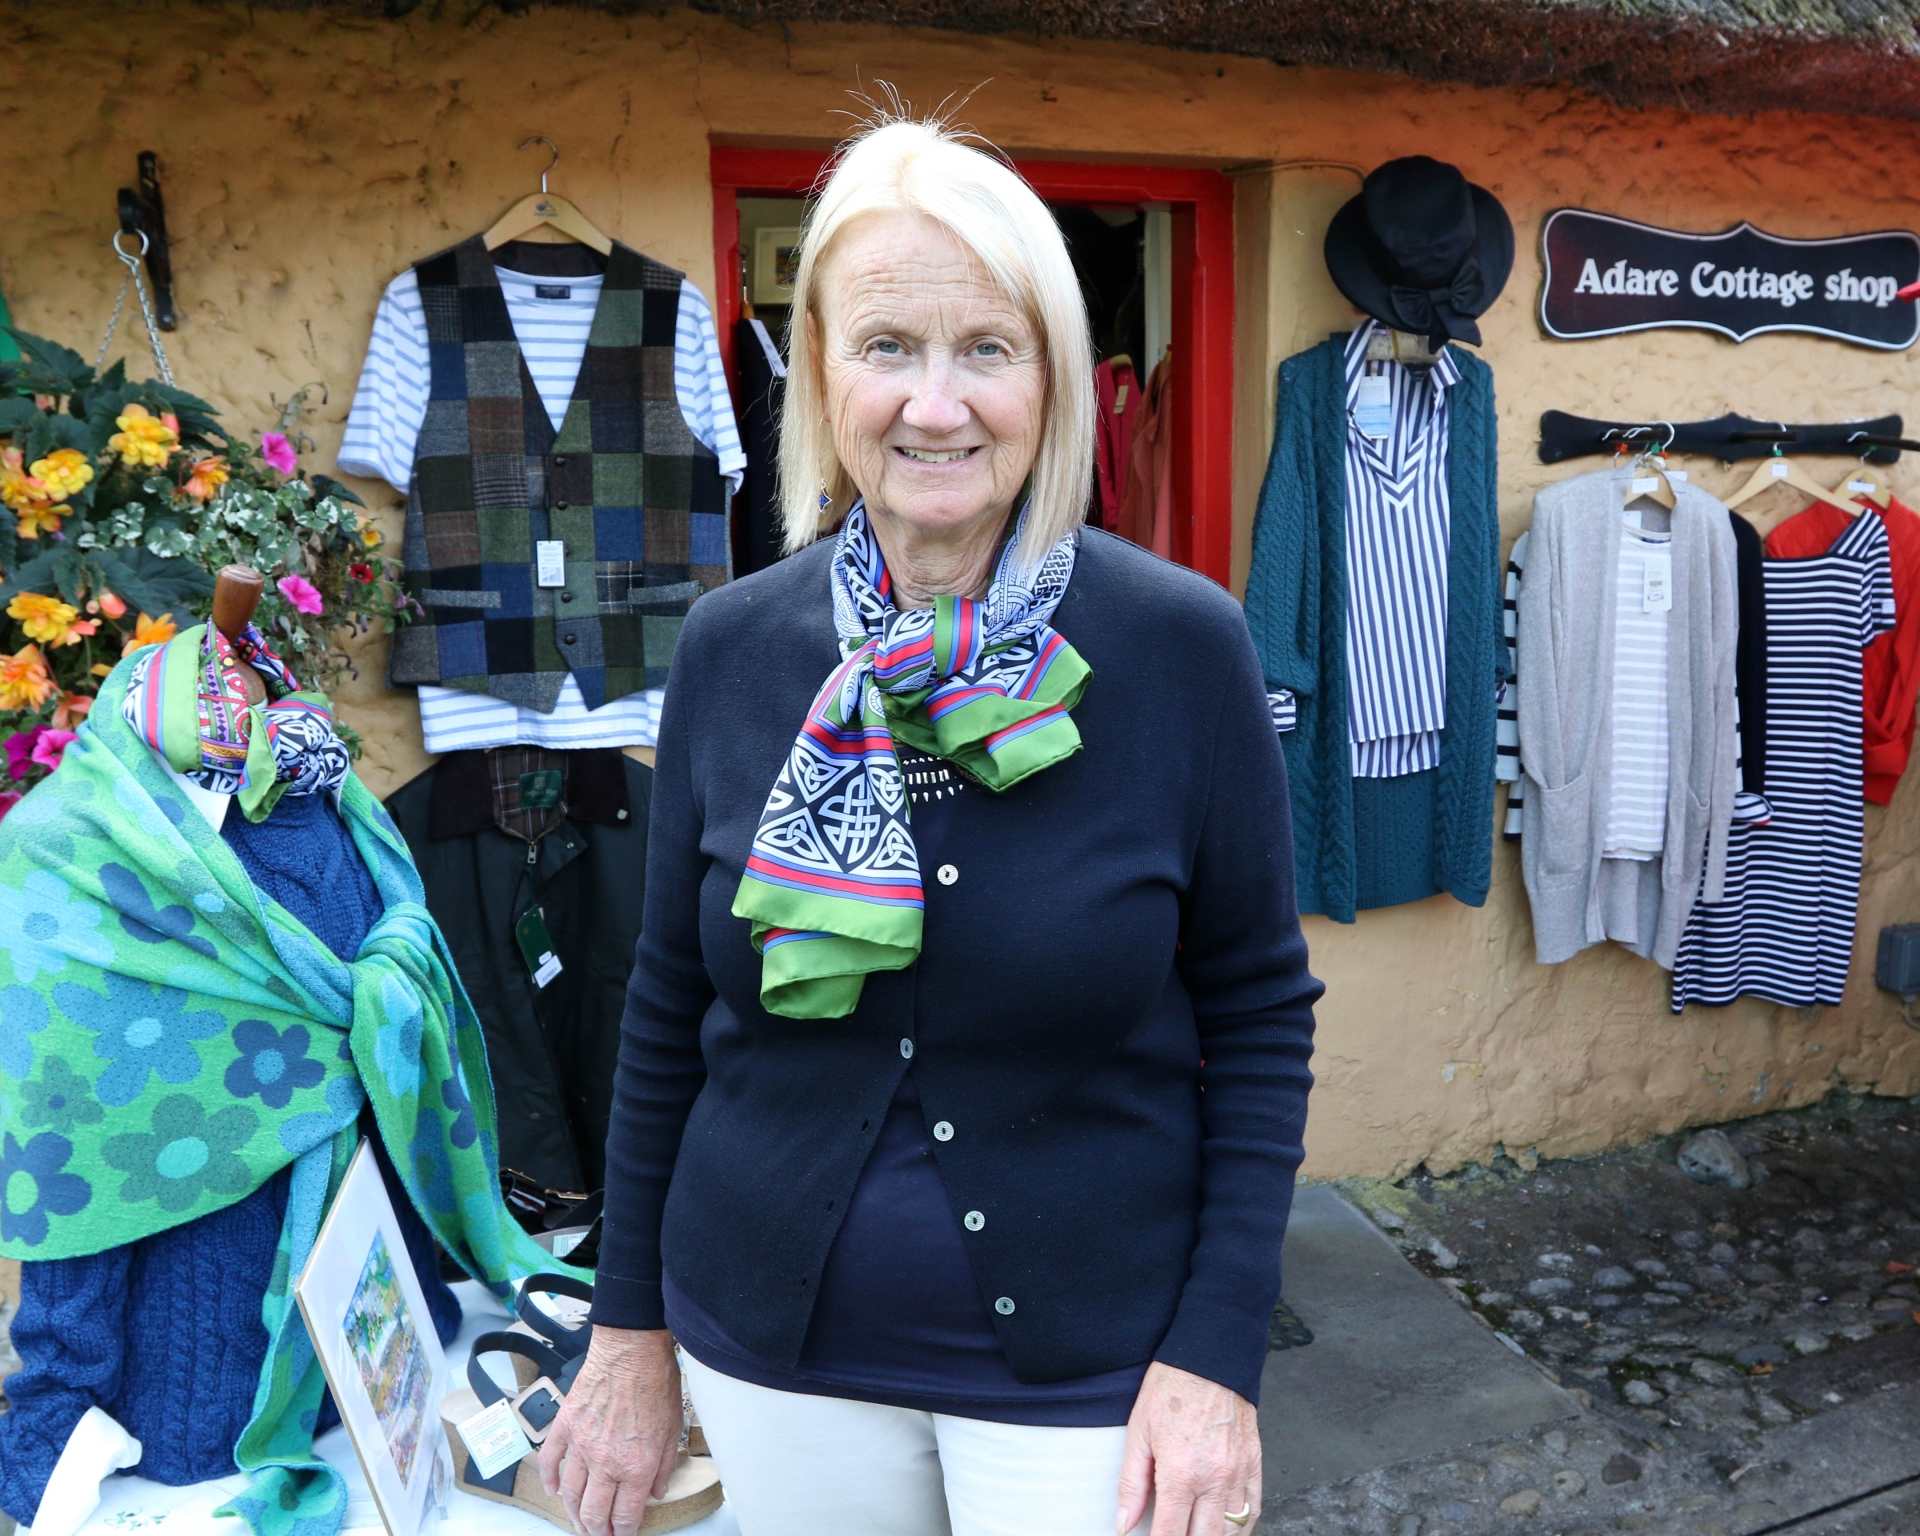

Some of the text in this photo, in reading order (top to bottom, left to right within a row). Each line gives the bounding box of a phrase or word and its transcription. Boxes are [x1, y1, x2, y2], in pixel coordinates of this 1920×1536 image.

[1574, 258, 1898, 308] Adare Cottage shop
